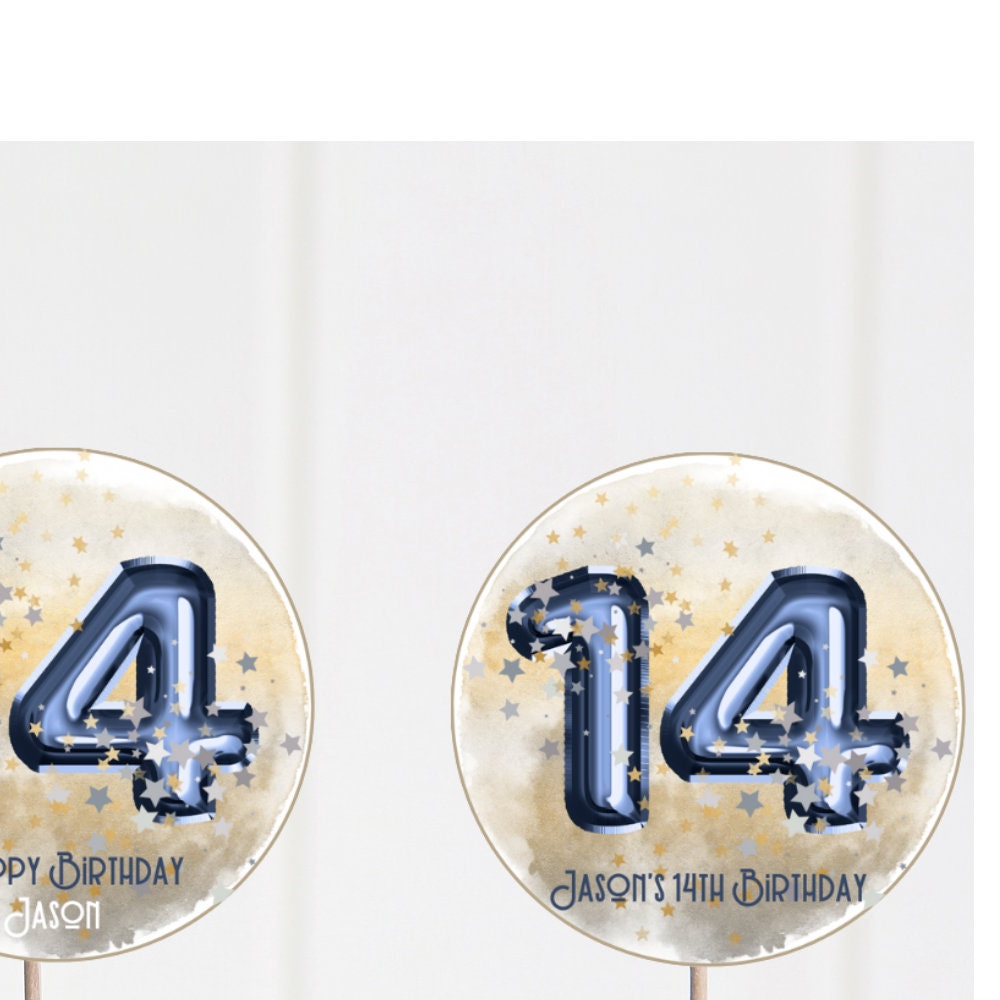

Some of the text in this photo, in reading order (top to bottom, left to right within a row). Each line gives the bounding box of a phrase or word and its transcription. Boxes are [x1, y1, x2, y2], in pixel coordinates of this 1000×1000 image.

[506, 565, 910, 835] 14
[550, 869, 665, 911] JASON'S
[672, 873, 725, 903] 14TH
[4, 897, 101, 938] JASON
